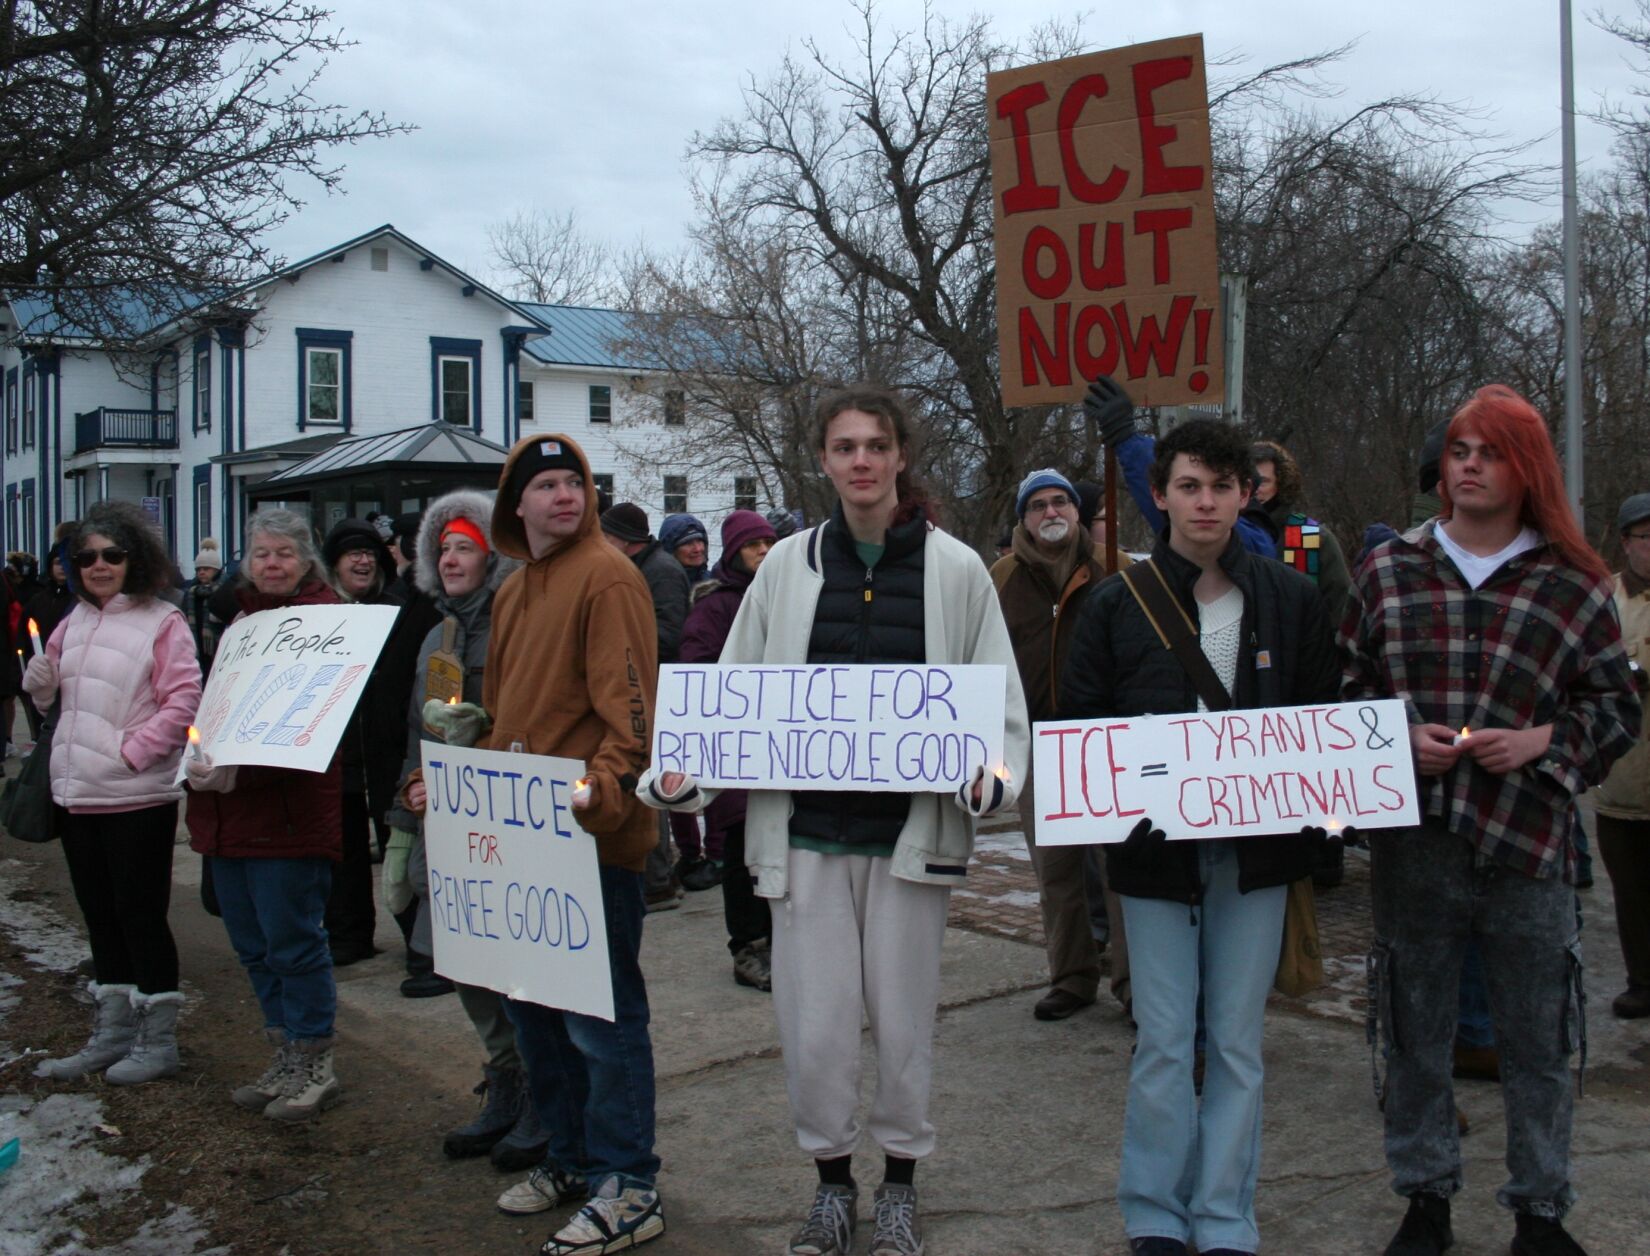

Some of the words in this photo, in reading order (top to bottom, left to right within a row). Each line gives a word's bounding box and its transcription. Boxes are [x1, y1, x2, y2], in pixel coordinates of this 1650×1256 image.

[996, 55, 1204, 218] ICE
[1022, 206, 1193, 300] OUT
[1018, 295, 1214, 394] NOW!
[261, 617, 352, 660] People...
[669, 667, 857, 723] JUSTICE
[869, 668, 958, 721] FOR
[658, 730, 761, 780] RENEE
[768, 729, 890, 783] NICOLE
[896, 731, 988, 782] GOOD
[1039, 723, 1146, 821] ICE
[1168, 708, 1357, 762] TYRANTS
[1358, 706, 1395, 750] &
[429, 760, 572, 838] JUSTICE
[1178, 765, 1405, 828] CRIMINALS
[468, 832, 503, 866] FOR
[431, 869, 500, 940] RENEE
[505, 882, 590, 951] GOOD
